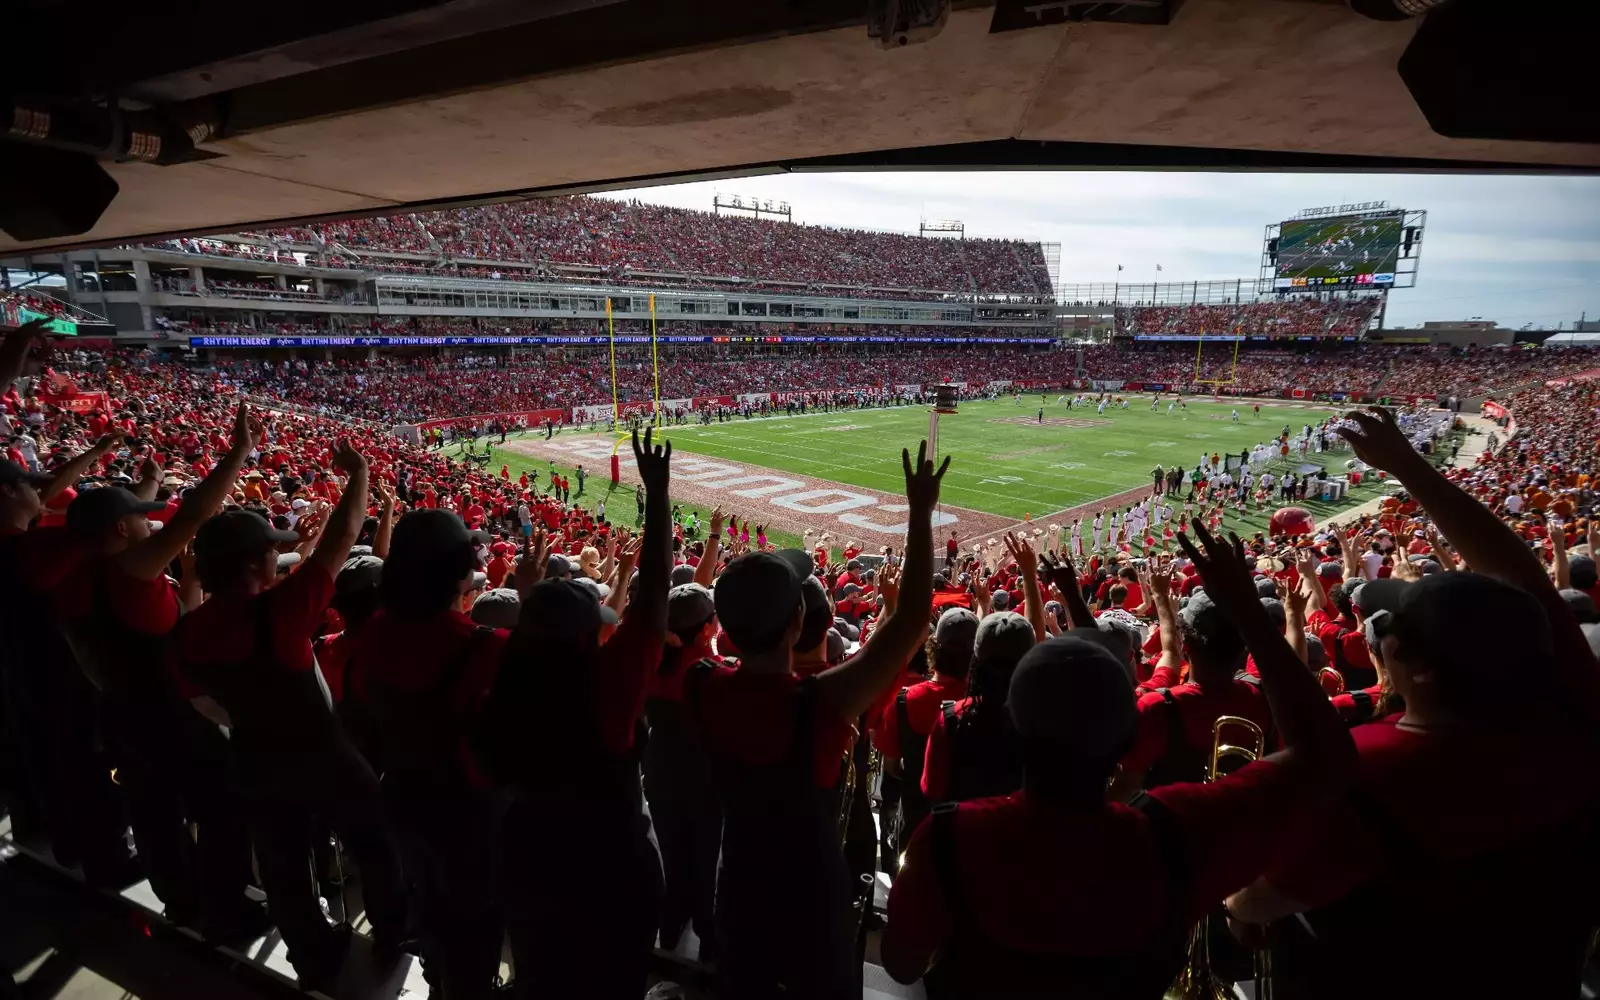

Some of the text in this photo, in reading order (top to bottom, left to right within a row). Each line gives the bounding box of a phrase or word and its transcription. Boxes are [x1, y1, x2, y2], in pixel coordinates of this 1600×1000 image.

[203, 337, 239, 346] RHYTHM
[240, 337, 271, 346] ENERGY
[301, 337, 329, 345] RHYTHM
[329, 337, 356, 345] ENERGY
[388, 337, 419, 345] RHYTHM
[420, 337, 446, 345] ENERGY
